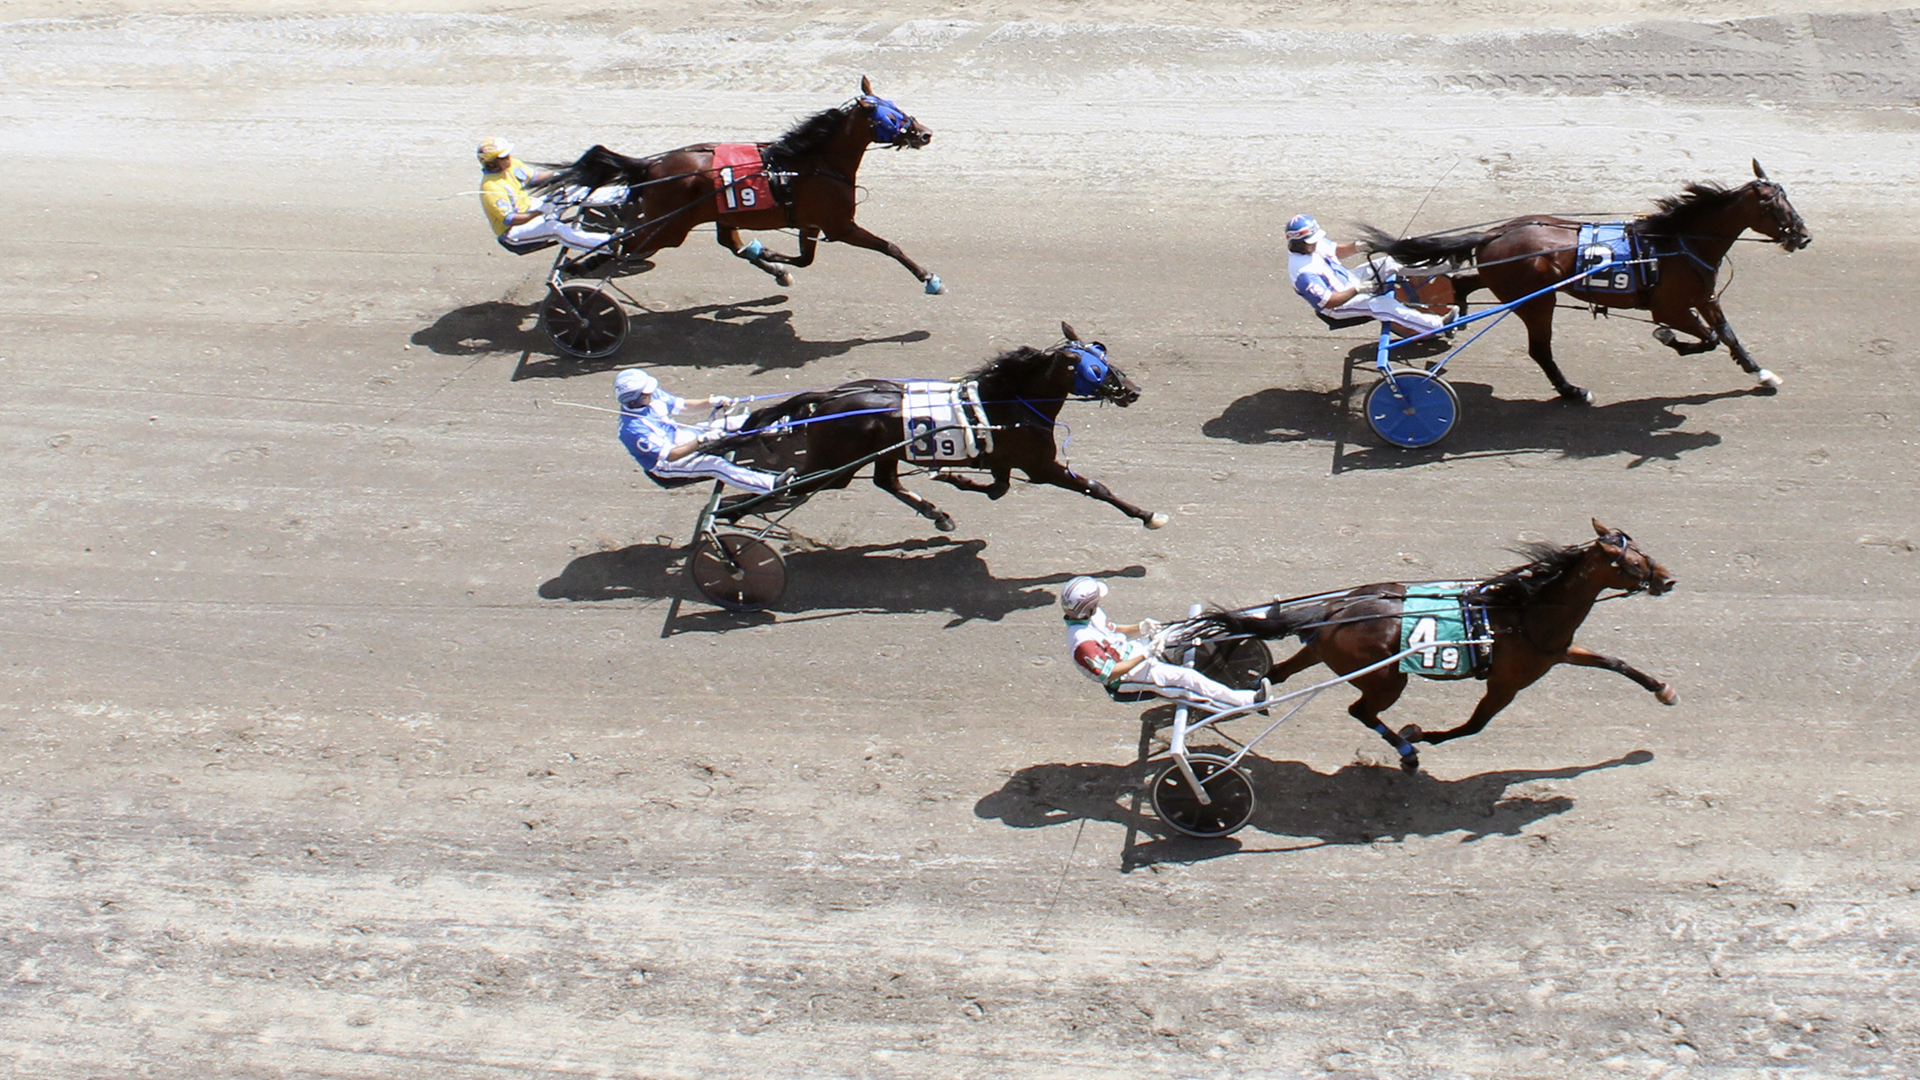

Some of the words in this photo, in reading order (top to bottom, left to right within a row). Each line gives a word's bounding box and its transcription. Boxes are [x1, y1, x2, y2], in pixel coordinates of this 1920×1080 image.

[720, 166, 737, 210] 1
[740, 187, 756, 207] 9
[1583, 244, 1613, 288] 2
[1613, 272, 1630, 290] 9
[908, 416, 937, 457] 3
[941, 439, 955, 456] 9
[1407, 615, 1438, 668] 4
[1441, 646, 1460, 671] 9
